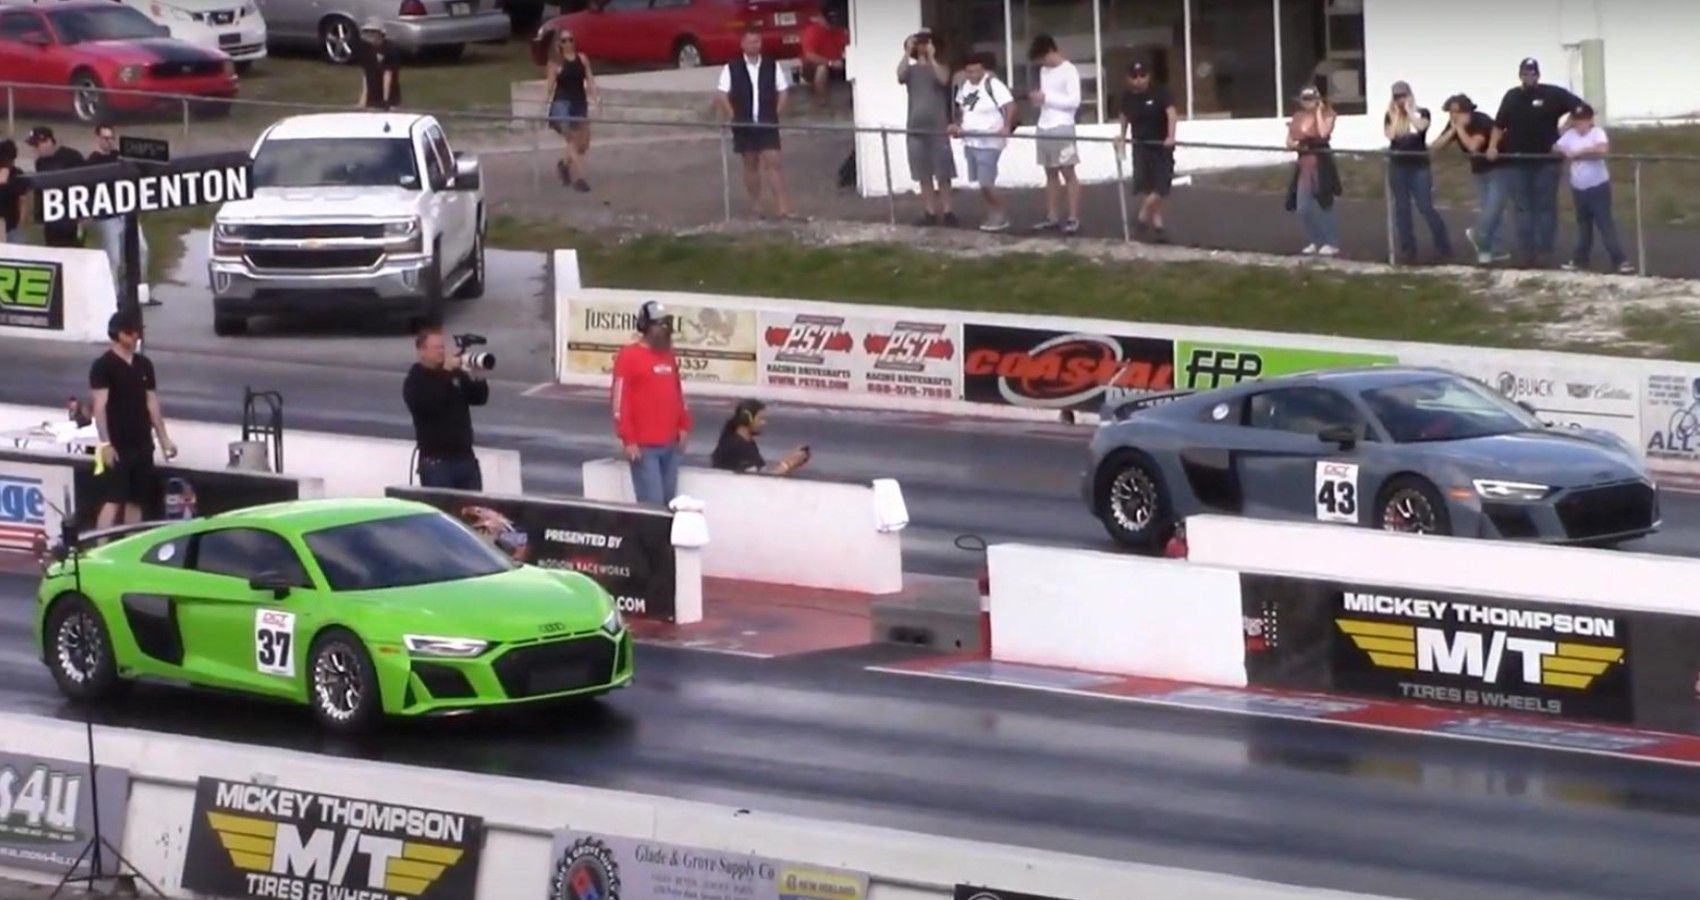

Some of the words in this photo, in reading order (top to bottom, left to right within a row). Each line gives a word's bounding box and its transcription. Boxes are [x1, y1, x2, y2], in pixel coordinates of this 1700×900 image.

[43, 166, 248, 222] BRADENTON
[965, 350, 1173, 391] COASTAL
[1518, 378, 1555, 397] BUICK
[1319, 480, 1355, 515] 43
[544, 529, 606, 547] PRESENTED
[607, 535, 623, 548] BY
[1343, 592, 1449, 620] MICKEY
[1452, 602, 1615, 637] THOMPSON
[258, 628, 291, 667] 37
[1415, 626, 1556, 684] M/T
[1400, 683, 1461, 703] TIRES
[1464, 688, 1478, 704] &
[1481, 690, 1562, 714] WHEELS
[216, 782, 313, 819] MICKEY
[318, 796, 465, 842] THOMPSON
[270, 822, 403, 889] M/T
[246, 873, 304, 900] TIRES
